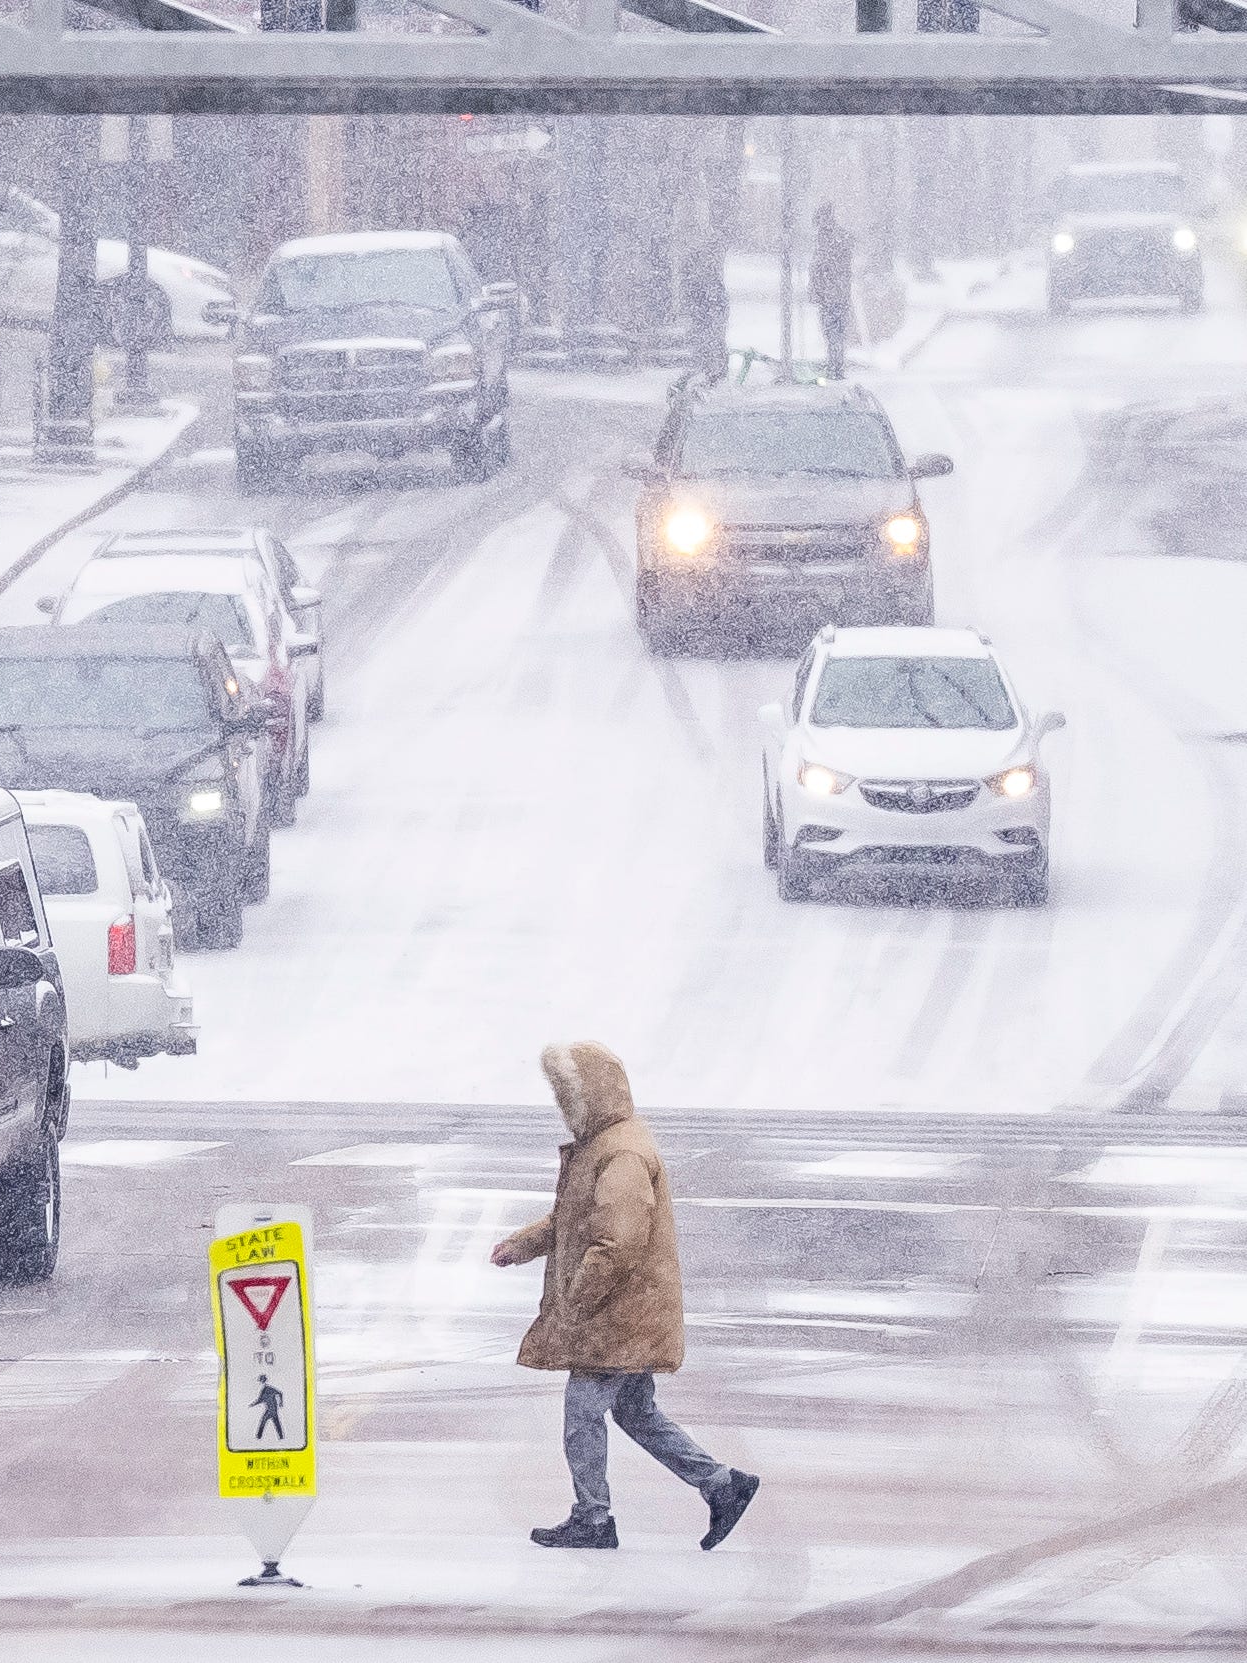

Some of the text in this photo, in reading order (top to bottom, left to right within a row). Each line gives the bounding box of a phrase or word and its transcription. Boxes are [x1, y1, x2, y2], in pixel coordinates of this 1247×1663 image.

[225, 1226, 284, 1251] STATE
[235, 1246, 276, 1263] LAW
[254, 1352, 275, 1365] TO
[228, 1474, 307, 1489] CROSSWALK
